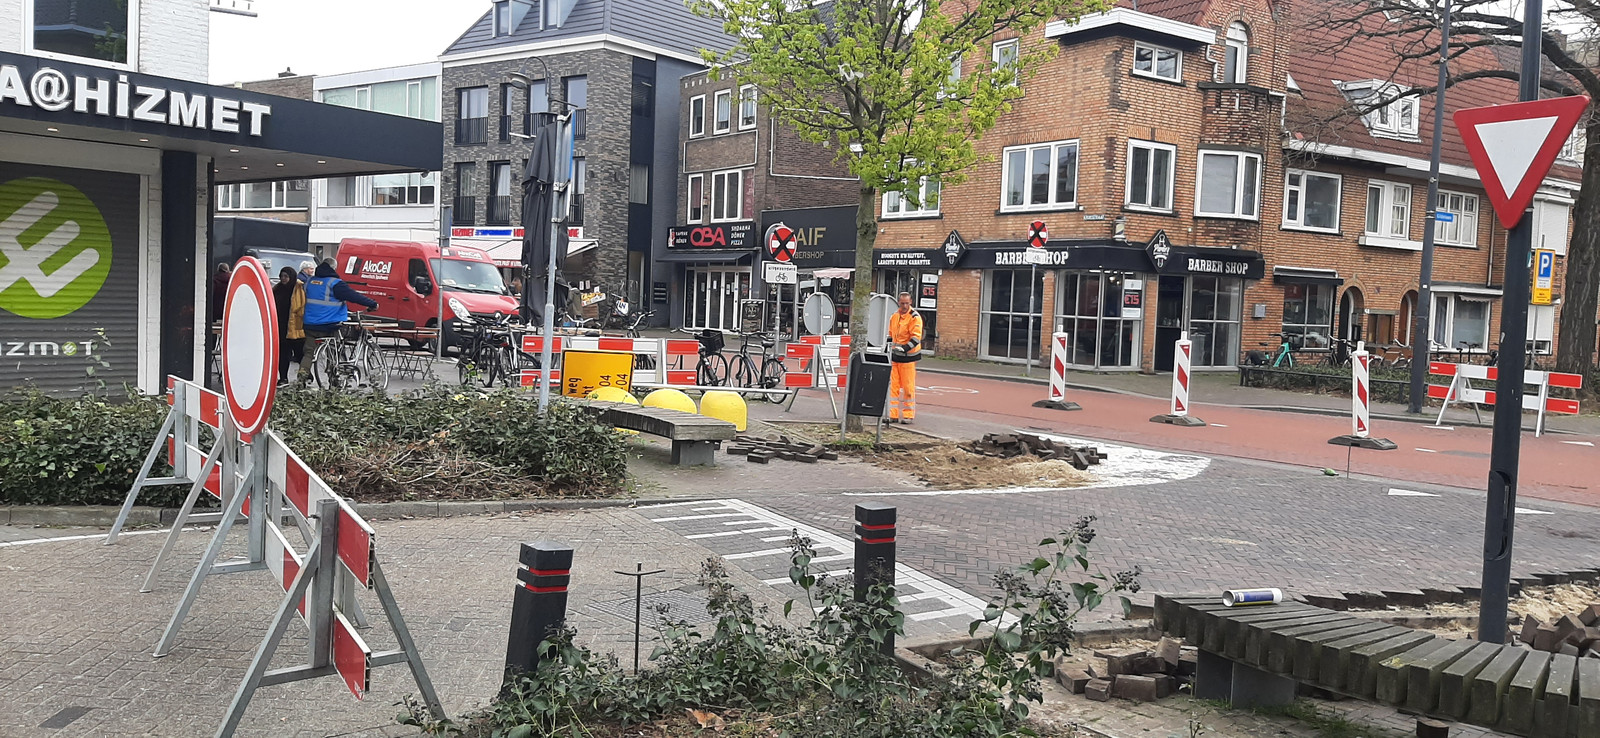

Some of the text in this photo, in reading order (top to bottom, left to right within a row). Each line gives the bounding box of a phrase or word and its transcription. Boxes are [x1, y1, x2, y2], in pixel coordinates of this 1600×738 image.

[690, 227, 726, 247] OBA
[793, 227, 827, 246] AIF
[792, 251, 825, 260] BERSHOP
[1045, 251, 1069, 264] HOP
[1540, 254, 1550, 275] P
[1188, 258, 1249, 275] BARBER SHOP
